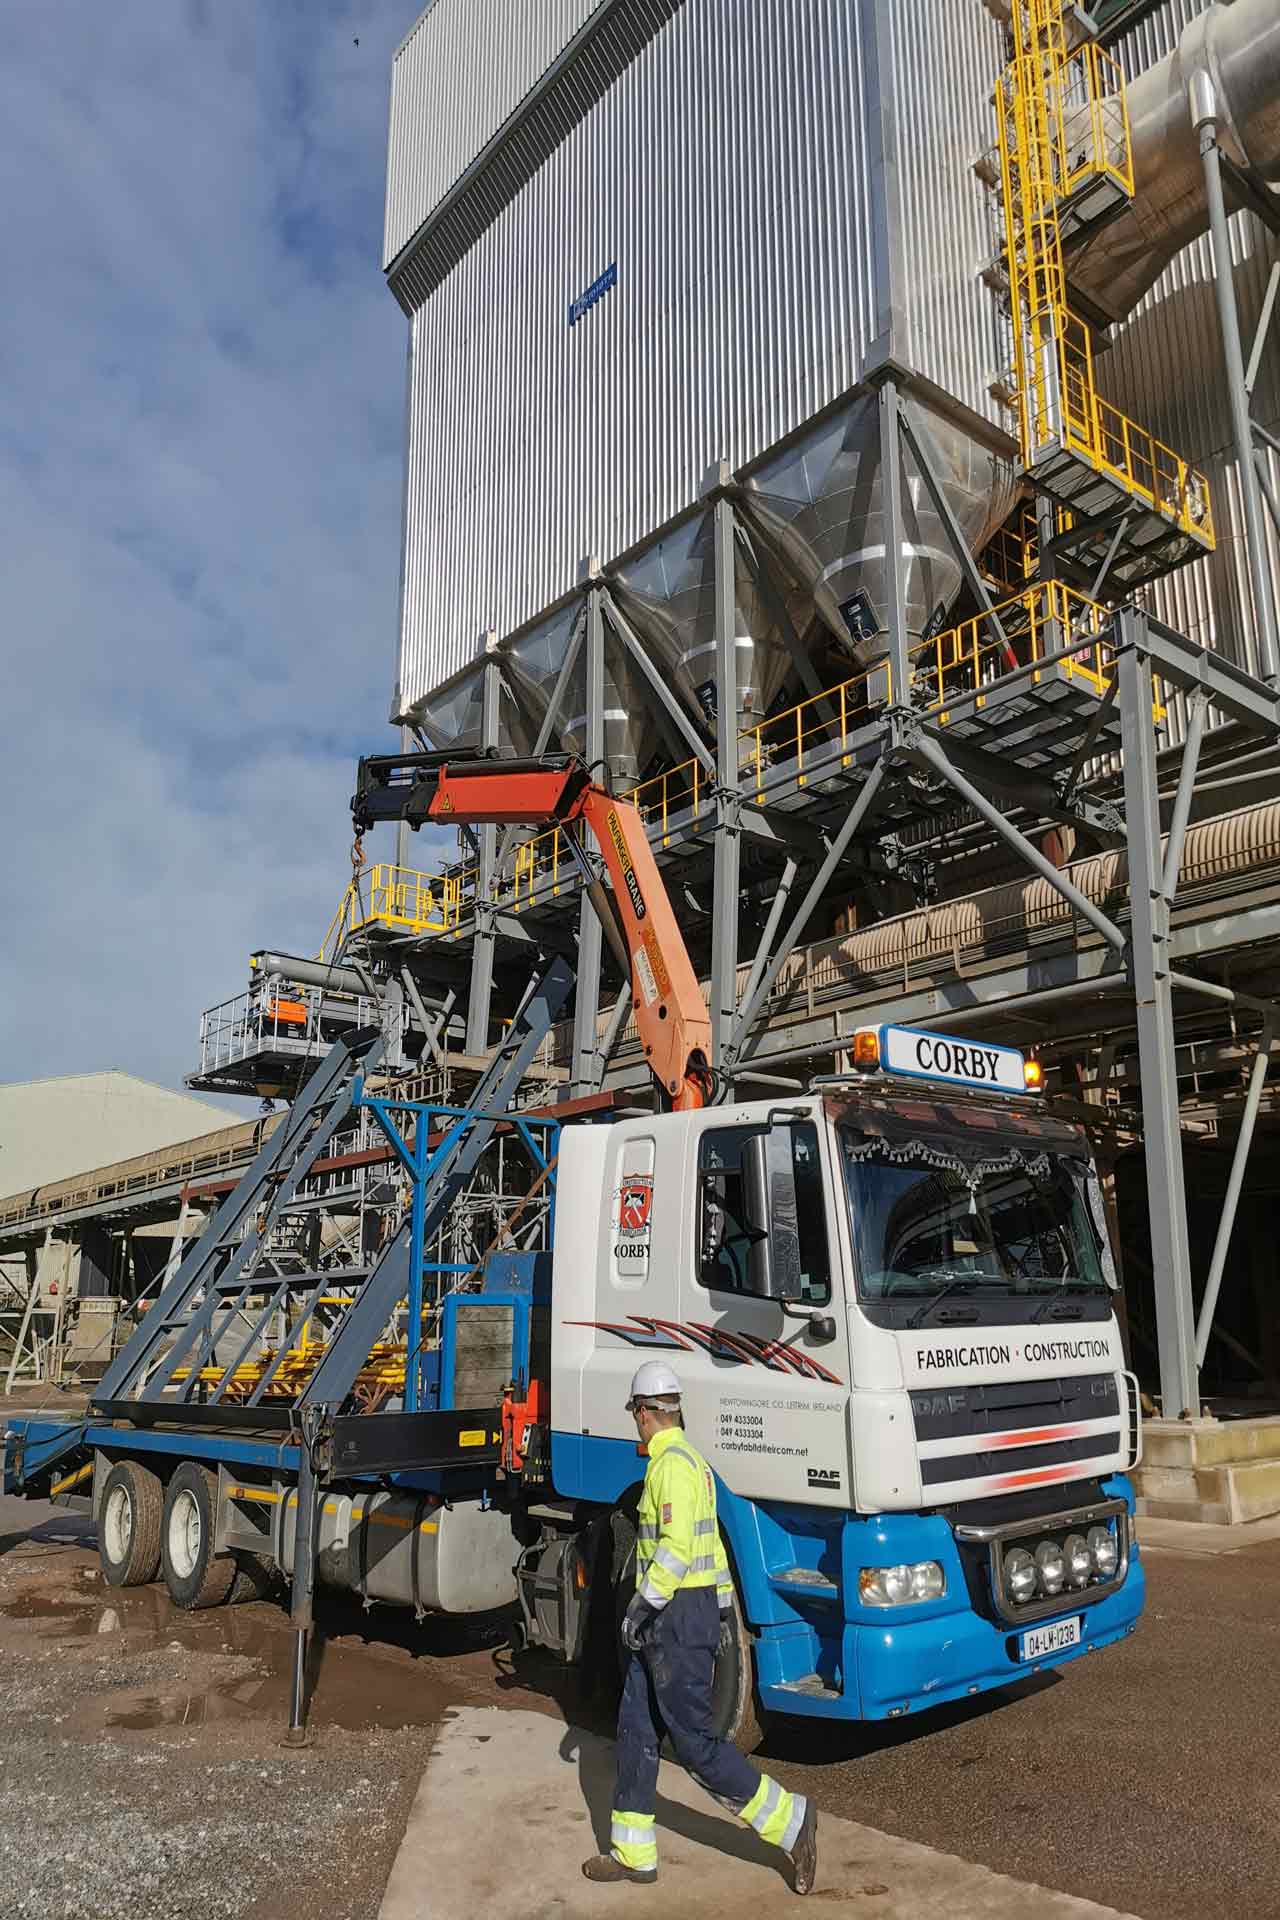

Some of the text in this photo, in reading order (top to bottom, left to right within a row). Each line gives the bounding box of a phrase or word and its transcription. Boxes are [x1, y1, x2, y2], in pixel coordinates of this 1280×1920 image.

[626, 870, 645, 917] CRANE
[916, 1038, 1000, 1081] CORBY
[614, 1244, 650, 1258] CORBY
[917, 1339, 1111, 1370] FABRICATION CONSTRUCTION
[720, 1414, 732, 1424] 049
[720, 1427, 732, 1437] 049
[807, 1468, 840, 1479] DAF
